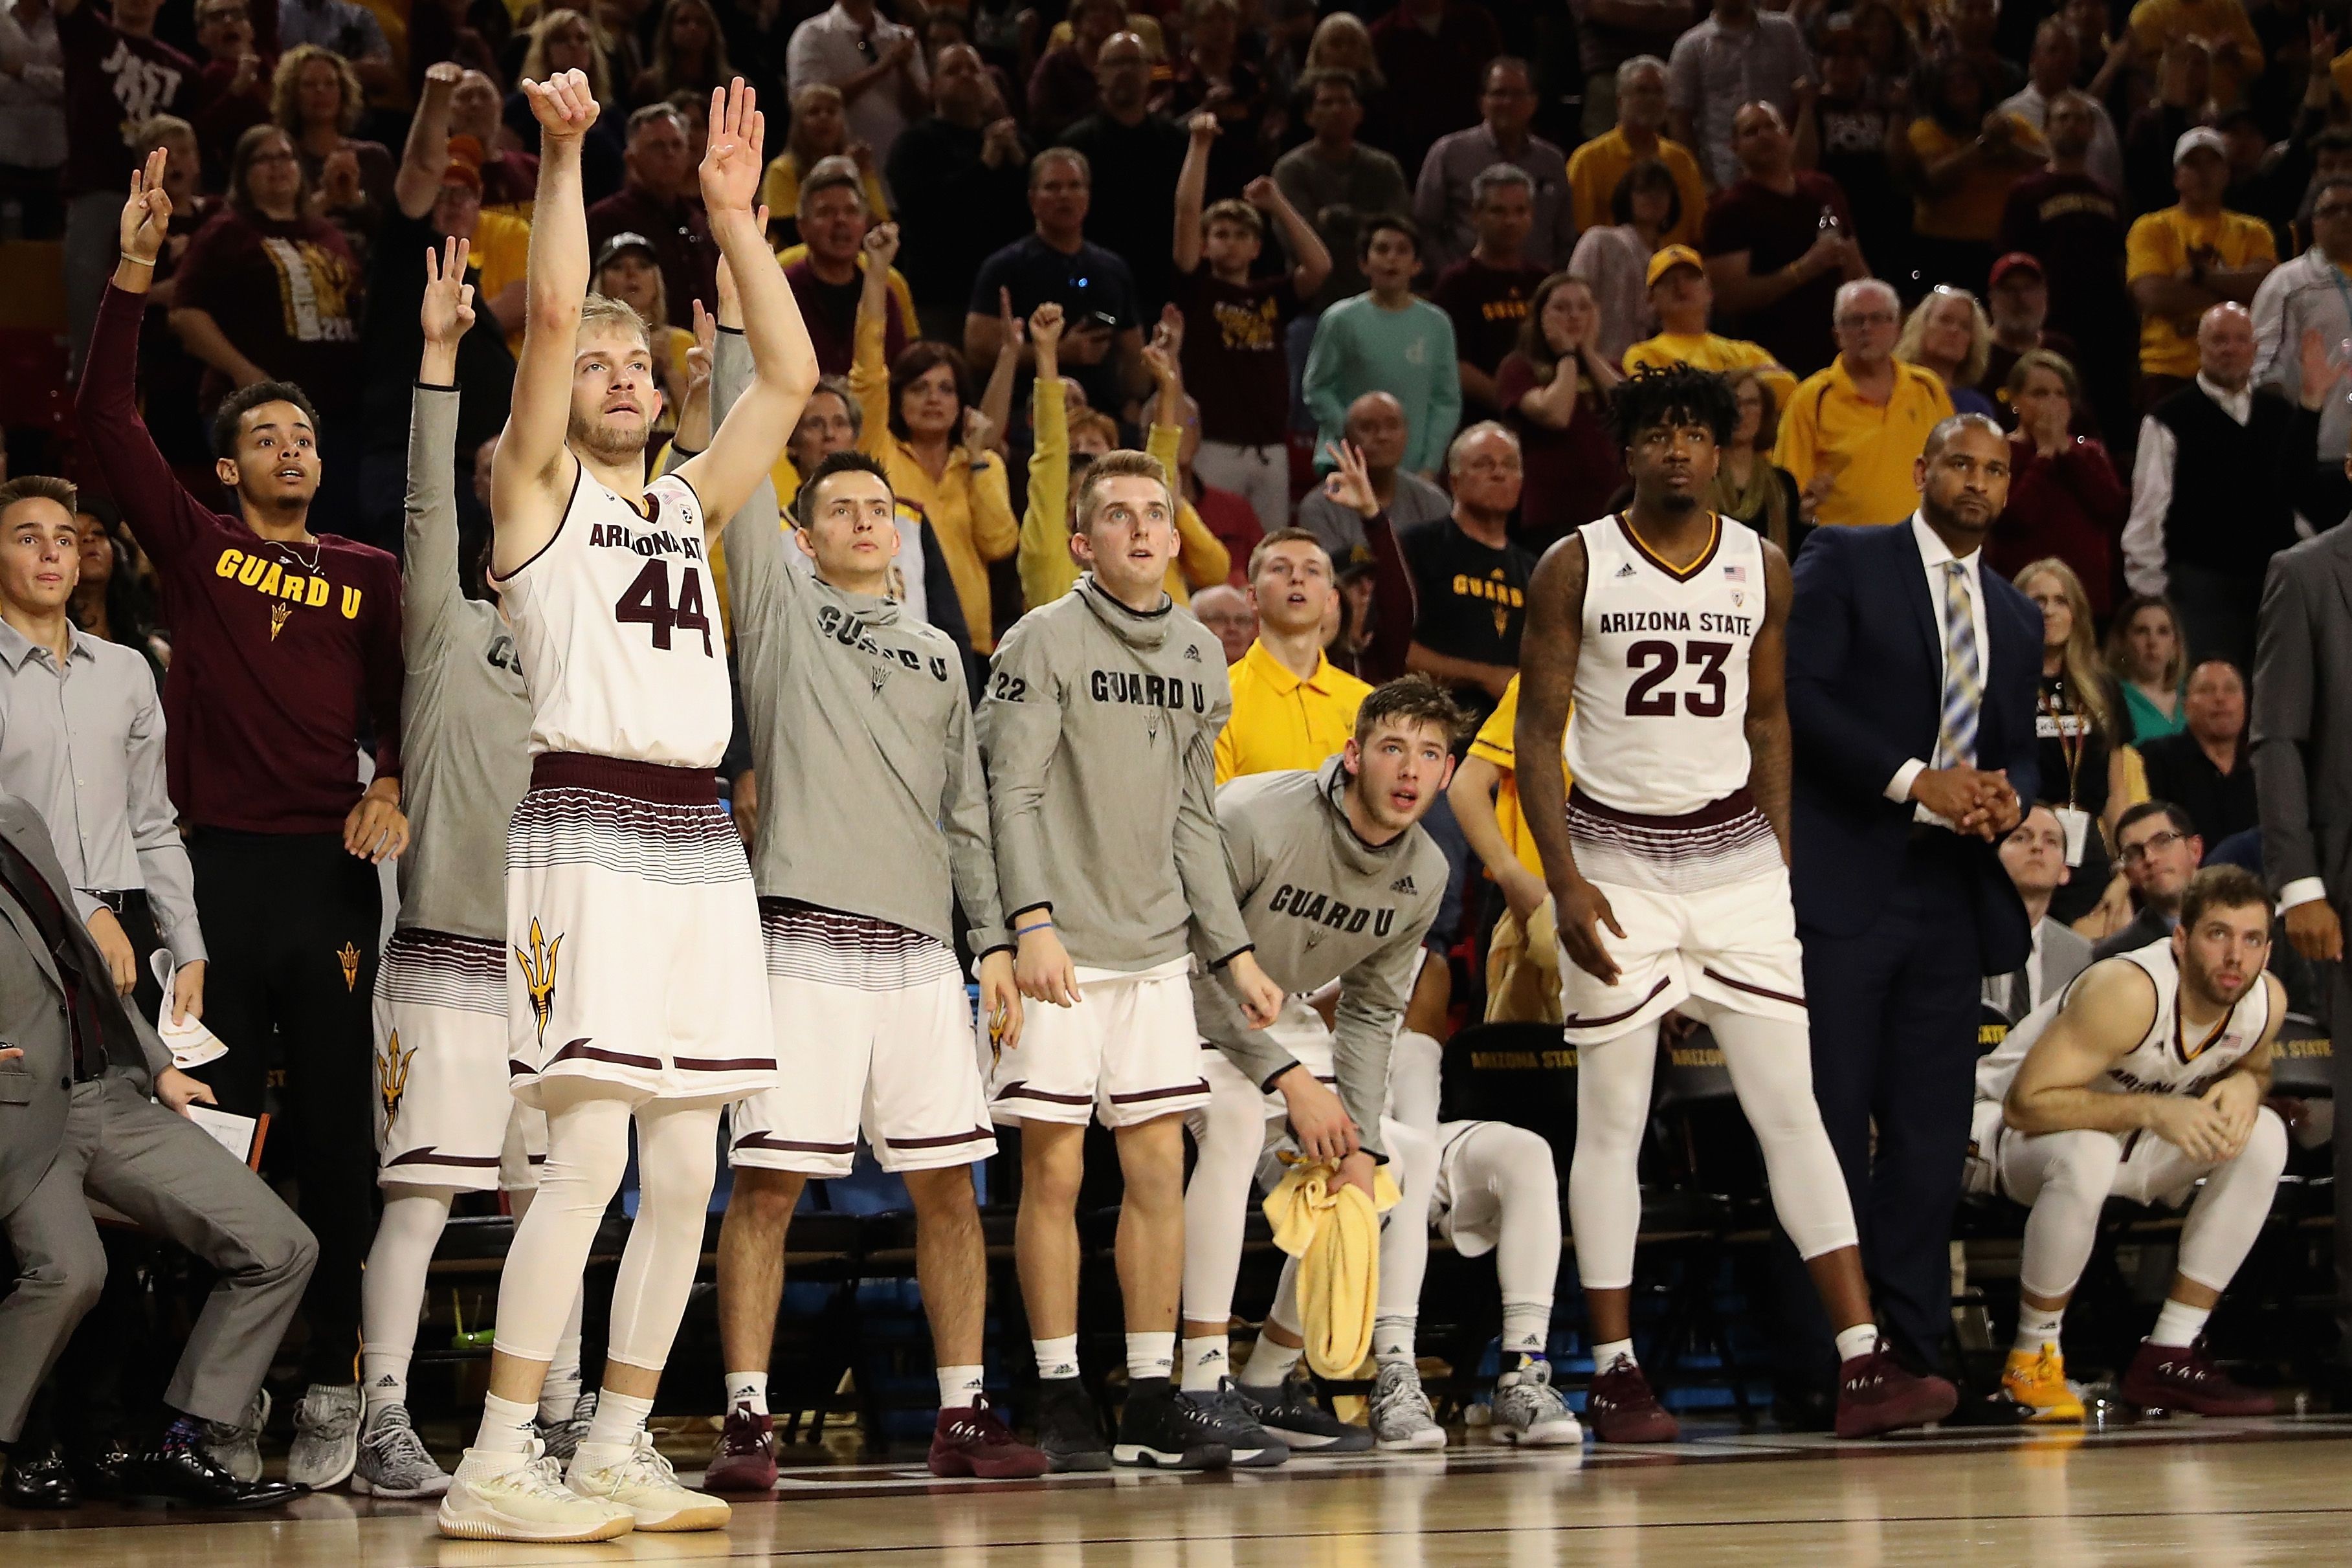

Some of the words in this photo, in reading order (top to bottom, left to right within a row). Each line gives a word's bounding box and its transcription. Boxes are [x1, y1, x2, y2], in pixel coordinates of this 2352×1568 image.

[216, 549, 330, 607] GUARD
[341, 585, 362, 619] U
[1452, 573, 1524, 608] GUARD
[616, 558, 713, 659] 44
[1600, 612, 1691, 634] ARIZONA
[1700, 613, 1751, 636] STATE
[929, 656, 948, 681] U
[995, 671, 1026, 703] 22
[1625, 640, 1733, 717] 23
[1091, 670, 1184, 709] GUARD
[1192, 681, 1204, 714] U
[1269, 884, 1370, 933] GUARD
[1373, 909, 1395, 937] U
